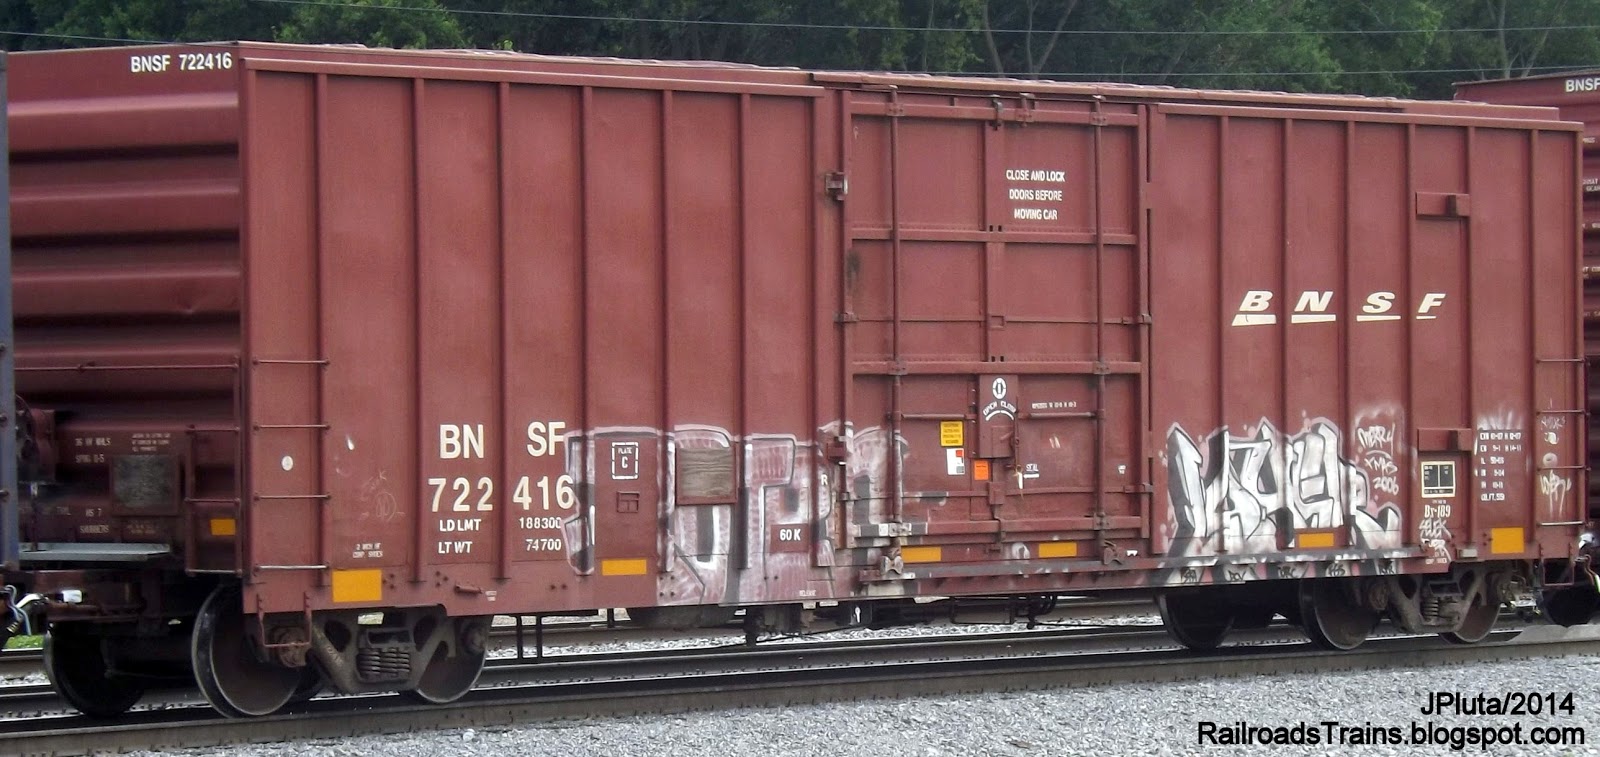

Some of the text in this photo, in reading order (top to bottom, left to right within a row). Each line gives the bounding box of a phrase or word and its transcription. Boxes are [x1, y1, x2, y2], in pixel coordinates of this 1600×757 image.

[130, 52, 233, 73] BNSF 722416
[1006, 169, 1066, 182] CLOSE AND LOCK
[1009, 188, 1063, 202] DOORS BEFORE
[1014, 208, 1058, 220] MOVING CAR
[439, 421, 566, 459] BN SF
[621, 456, 629, 469] C
[427, 474, 575, 513] 722 416
[1372, 475, 1400, 496] 2006
[439, 516, 562, 532] LD LMT 188300
[779, 528, 802, 542] 60 K
[438, 538, 562, 554] LT WT 74700
